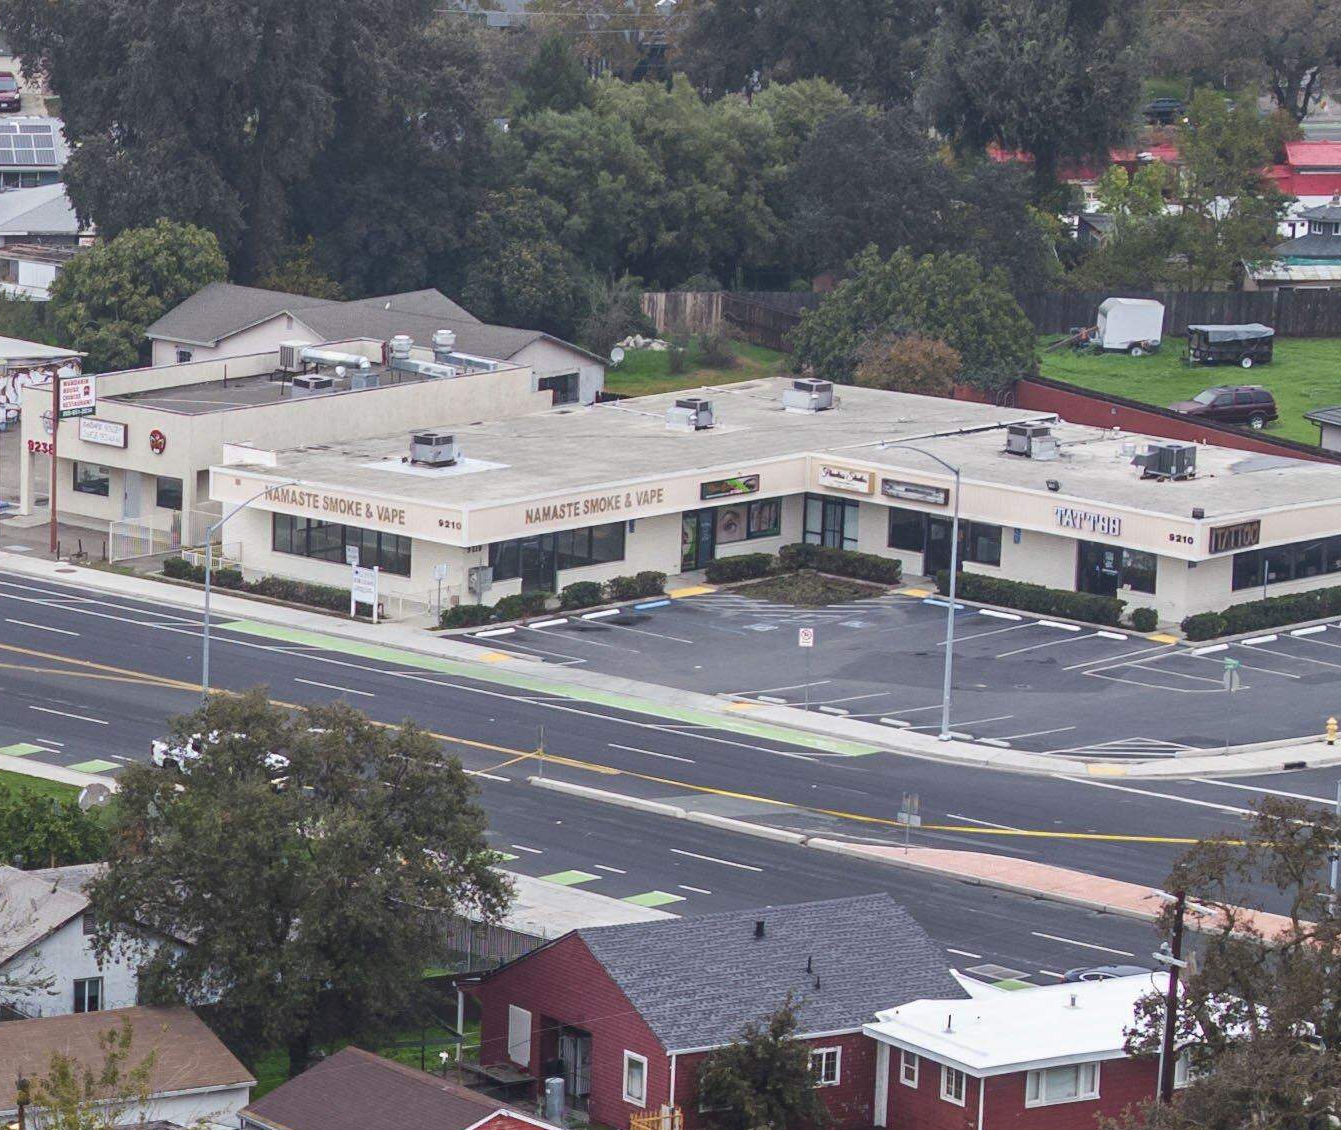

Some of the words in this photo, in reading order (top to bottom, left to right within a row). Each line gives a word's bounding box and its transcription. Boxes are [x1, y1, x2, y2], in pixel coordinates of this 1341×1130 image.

[265, 485, 319, 510] NAMASTE
[322, 495, 362, 518] SMOKE
[365, 503, 373, 518] &
[377, 505, 406, 526] VAPE
[524, 501, 581, 525] NAMASTE
[583, 494, 621, 516] SMOKE
[624, 493, 632, 508] &
[636, 487, 665, 507] VAPE
[437, 518, 462, 531] 9210
[1168, 532, 1194, 545] 9210
[1217, 521, 1259, 550] TATTOO
